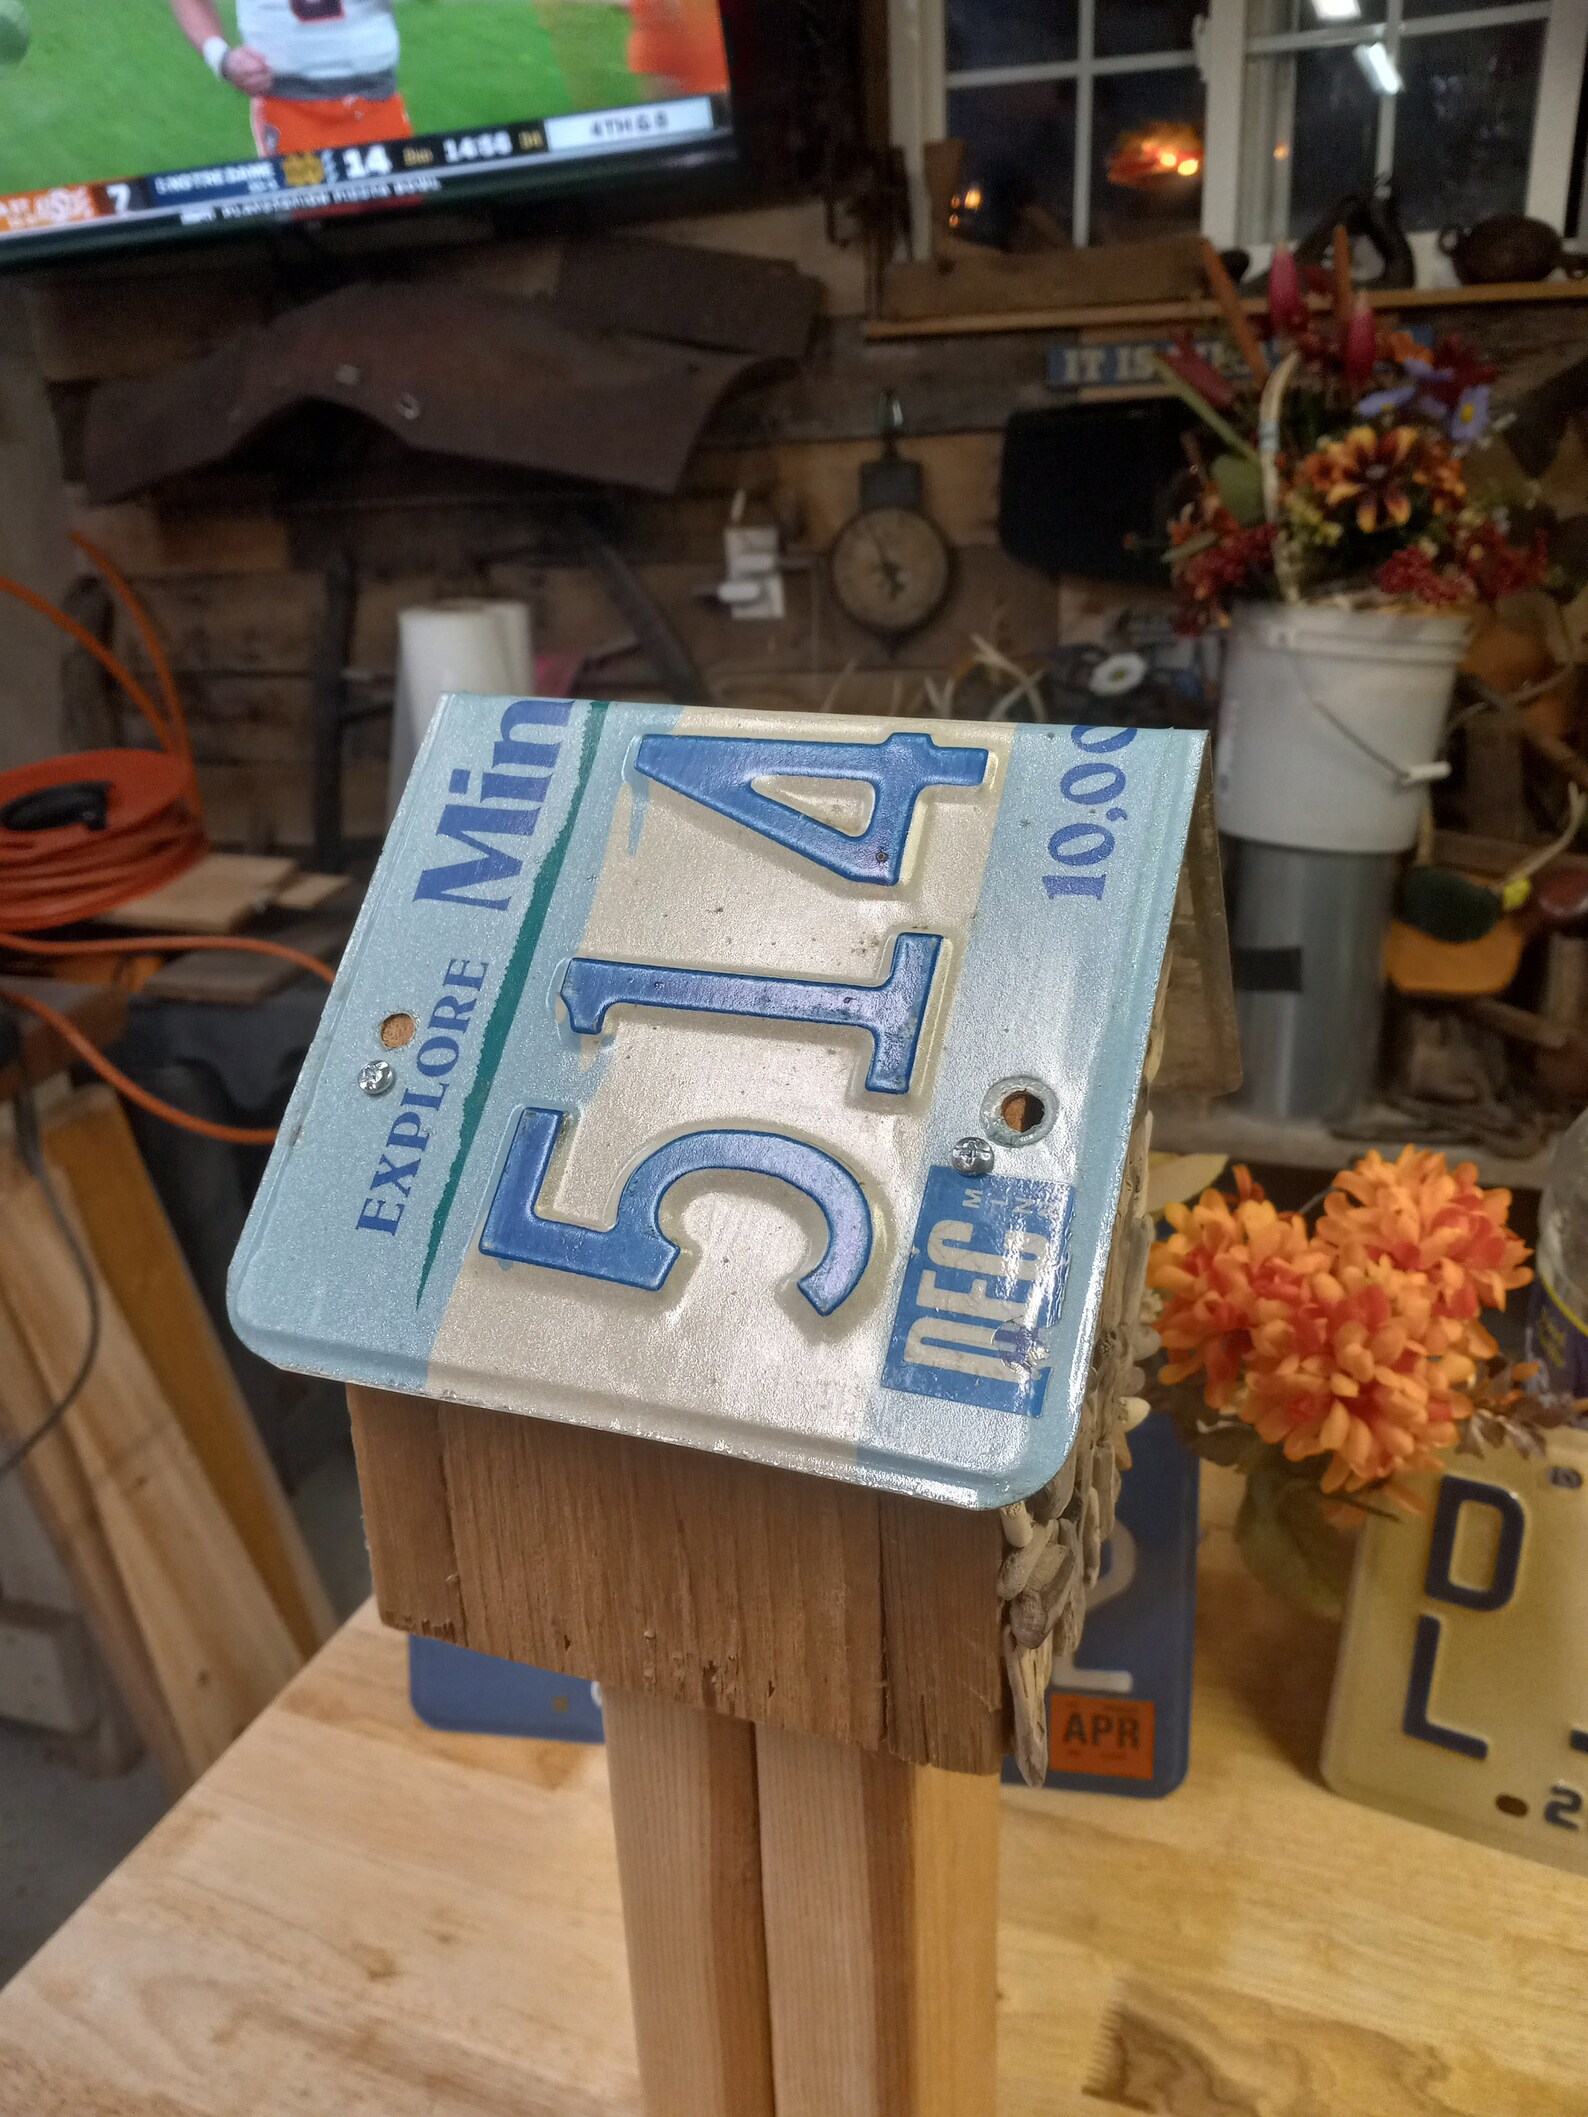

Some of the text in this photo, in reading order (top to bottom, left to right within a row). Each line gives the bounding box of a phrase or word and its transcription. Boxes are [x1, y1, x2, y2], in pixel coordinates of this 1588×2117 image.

[106, 183, 130, 216] 7
[342, 144, 393, 179] 14
[1064, 346, 1107, 382] IT
[412, 700, 576, 911] Min
[479, 733, 990, 1317] 514
[355, 958, 488, 1237] EXPLORE
[903, 1219, 1052, 1385] DEC
[1063, 1711, 1140, 1751] APR
